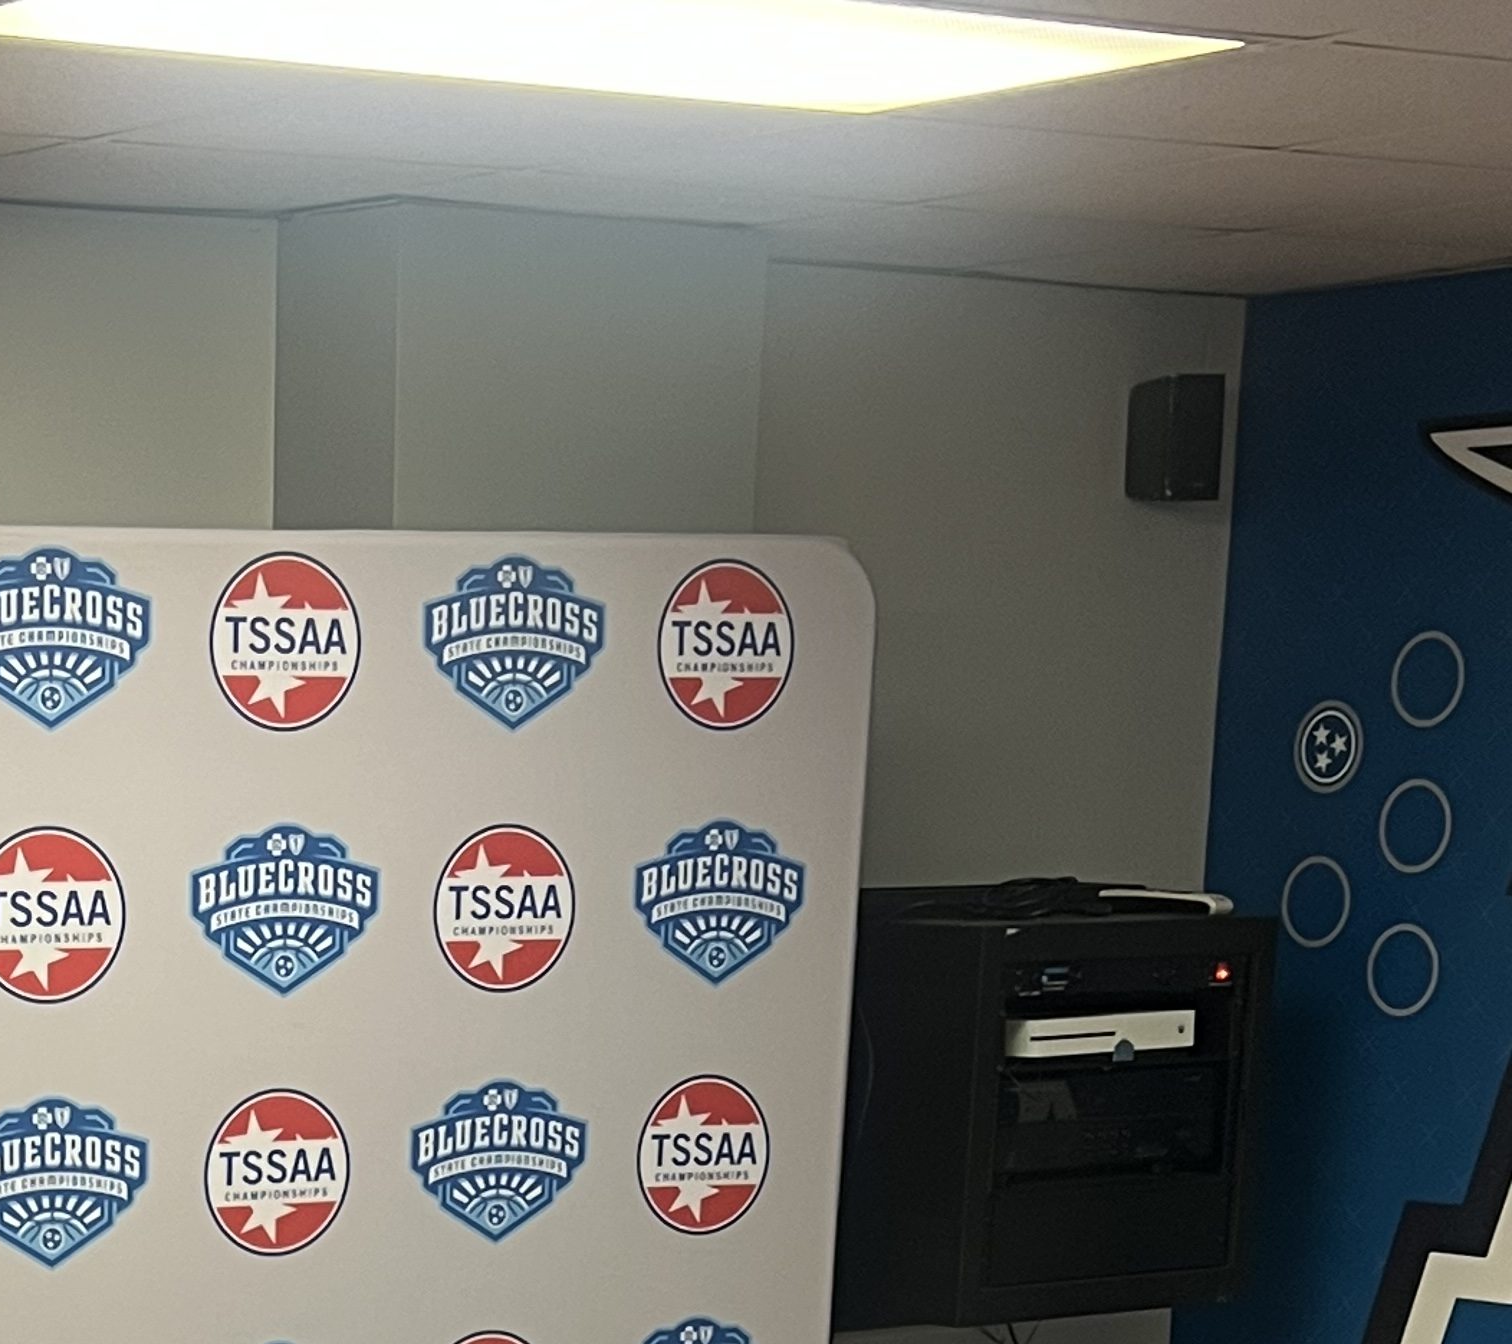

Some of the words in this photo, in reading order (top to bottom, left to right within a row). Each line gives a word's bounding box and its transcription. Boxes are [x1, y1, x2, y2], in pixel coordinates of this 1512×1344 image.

[432, 592, 598, 644] BLUECROSS
[19, 629, 125, 654] CHAMPIONSHIPS
[225, 616, 346, 654] TSSAA
[448, 640, 480, 658] STATE
[486, 635, 581, 659] CHAMPIONSHIPS
[672, 621, 781, 656] TSSAA
[231, 660, 338, 672] CHAMPIONSHIPS
[676, 663, 773, 673] CHAMPIONSHIPS
[199, 859, 371, 912] BLUECROSS
[642, 854, 798, 904] BLUECROSS
[216, 908, 249, 925] STATE
[256, 902, 354, 923] CHAMPIONSHIPS
[449, 884, 561, 920] TSSAA
[657, 900, 687, 917] STATE
[693, 895, 781, 916] CHAMPIONSHIPS
[453, 925, 554, 936] CHAMPIONSHIPS
[418, 1113, 580, 1165] BLUECROSS
[652, 1132, 756, 1166] TSSAA
[220, 1147, 336, 1185] TSSAA
[434, 1160, 465, 1178] STATE
[471, 1153, 563, 1173] CHAMPIONSHIPS
[655, 1171, 749, 1182] CHAMPIONSHIPS
[22, 1175, 123, 1194] CHAMPIONSHIPS
[224, 1188, 328, 1202] CHAMPIONSHIPS
